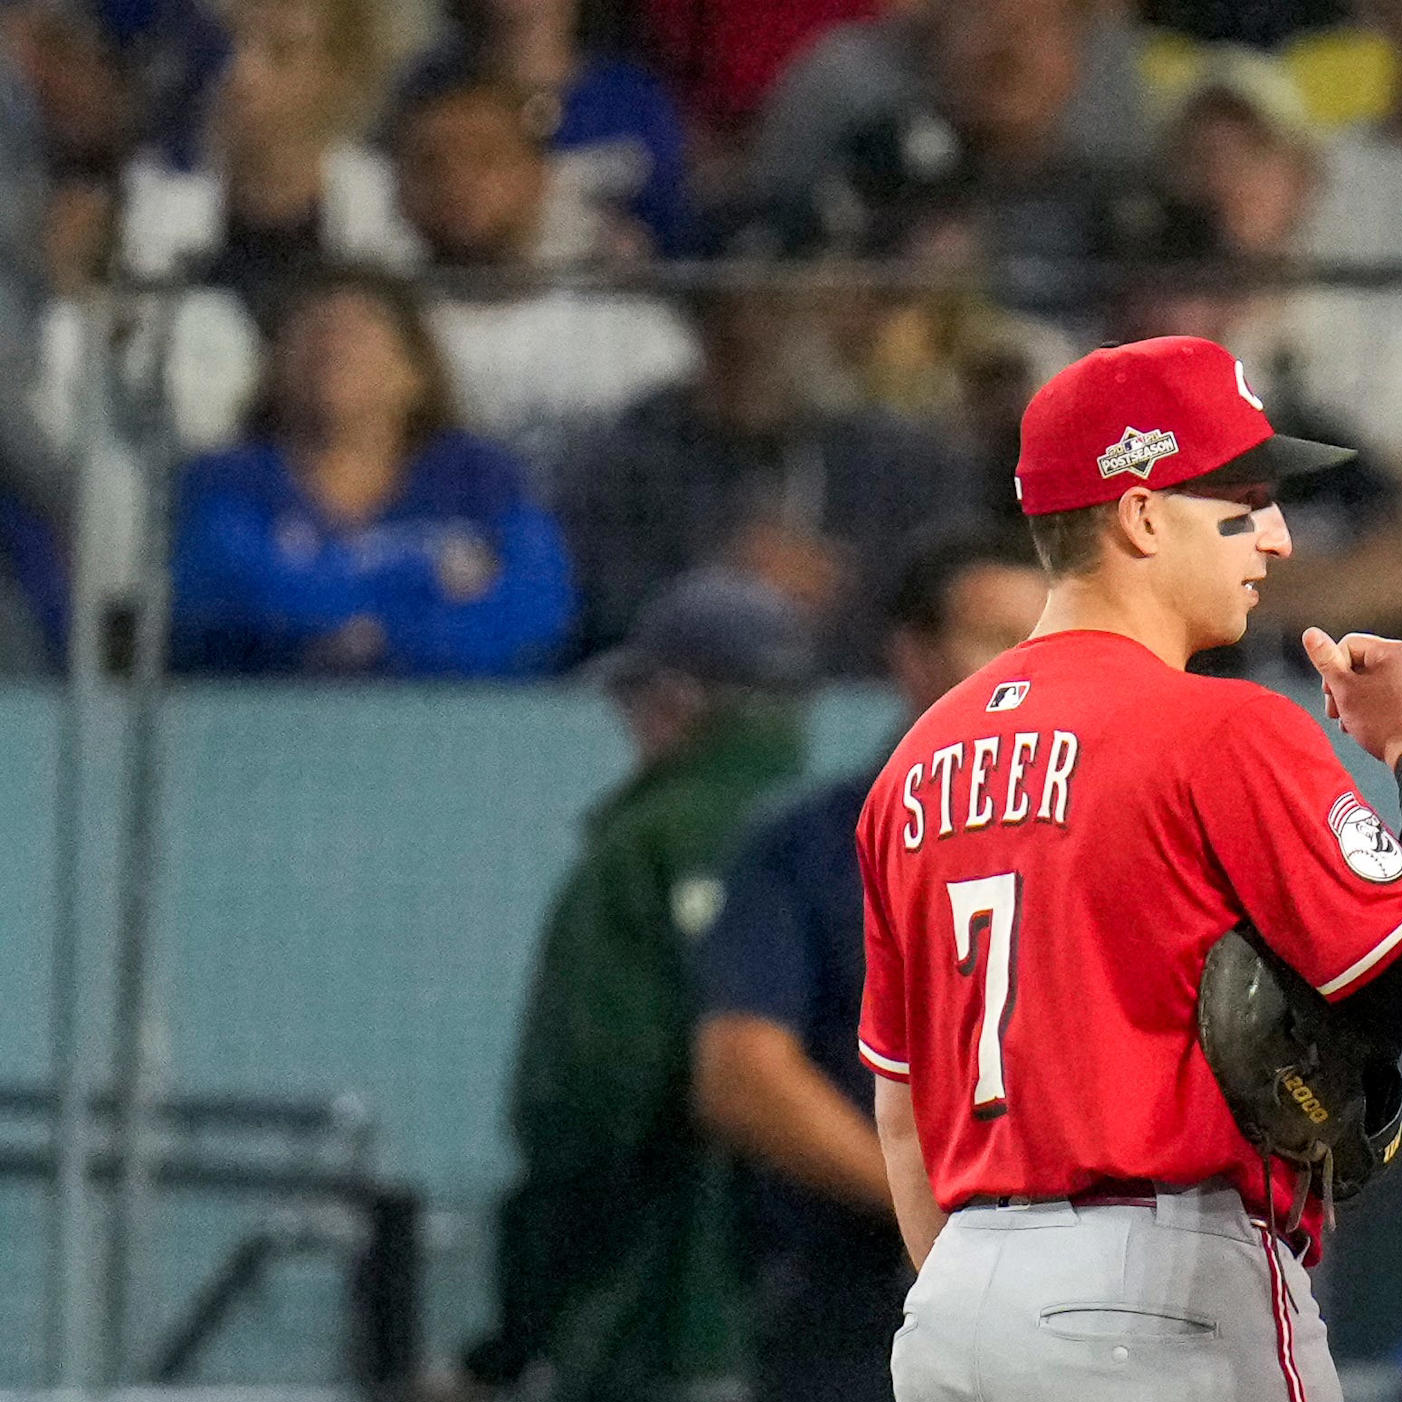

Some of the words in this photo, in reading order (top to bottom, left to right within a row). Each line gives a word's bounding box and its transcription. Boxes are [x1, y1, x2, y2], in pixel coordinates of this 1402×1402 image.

[1101, 439, 1175, 473] POSTSEASON
[903, 729, 1079, 853] STEER
[946, 872, 1023, 1121] 7
